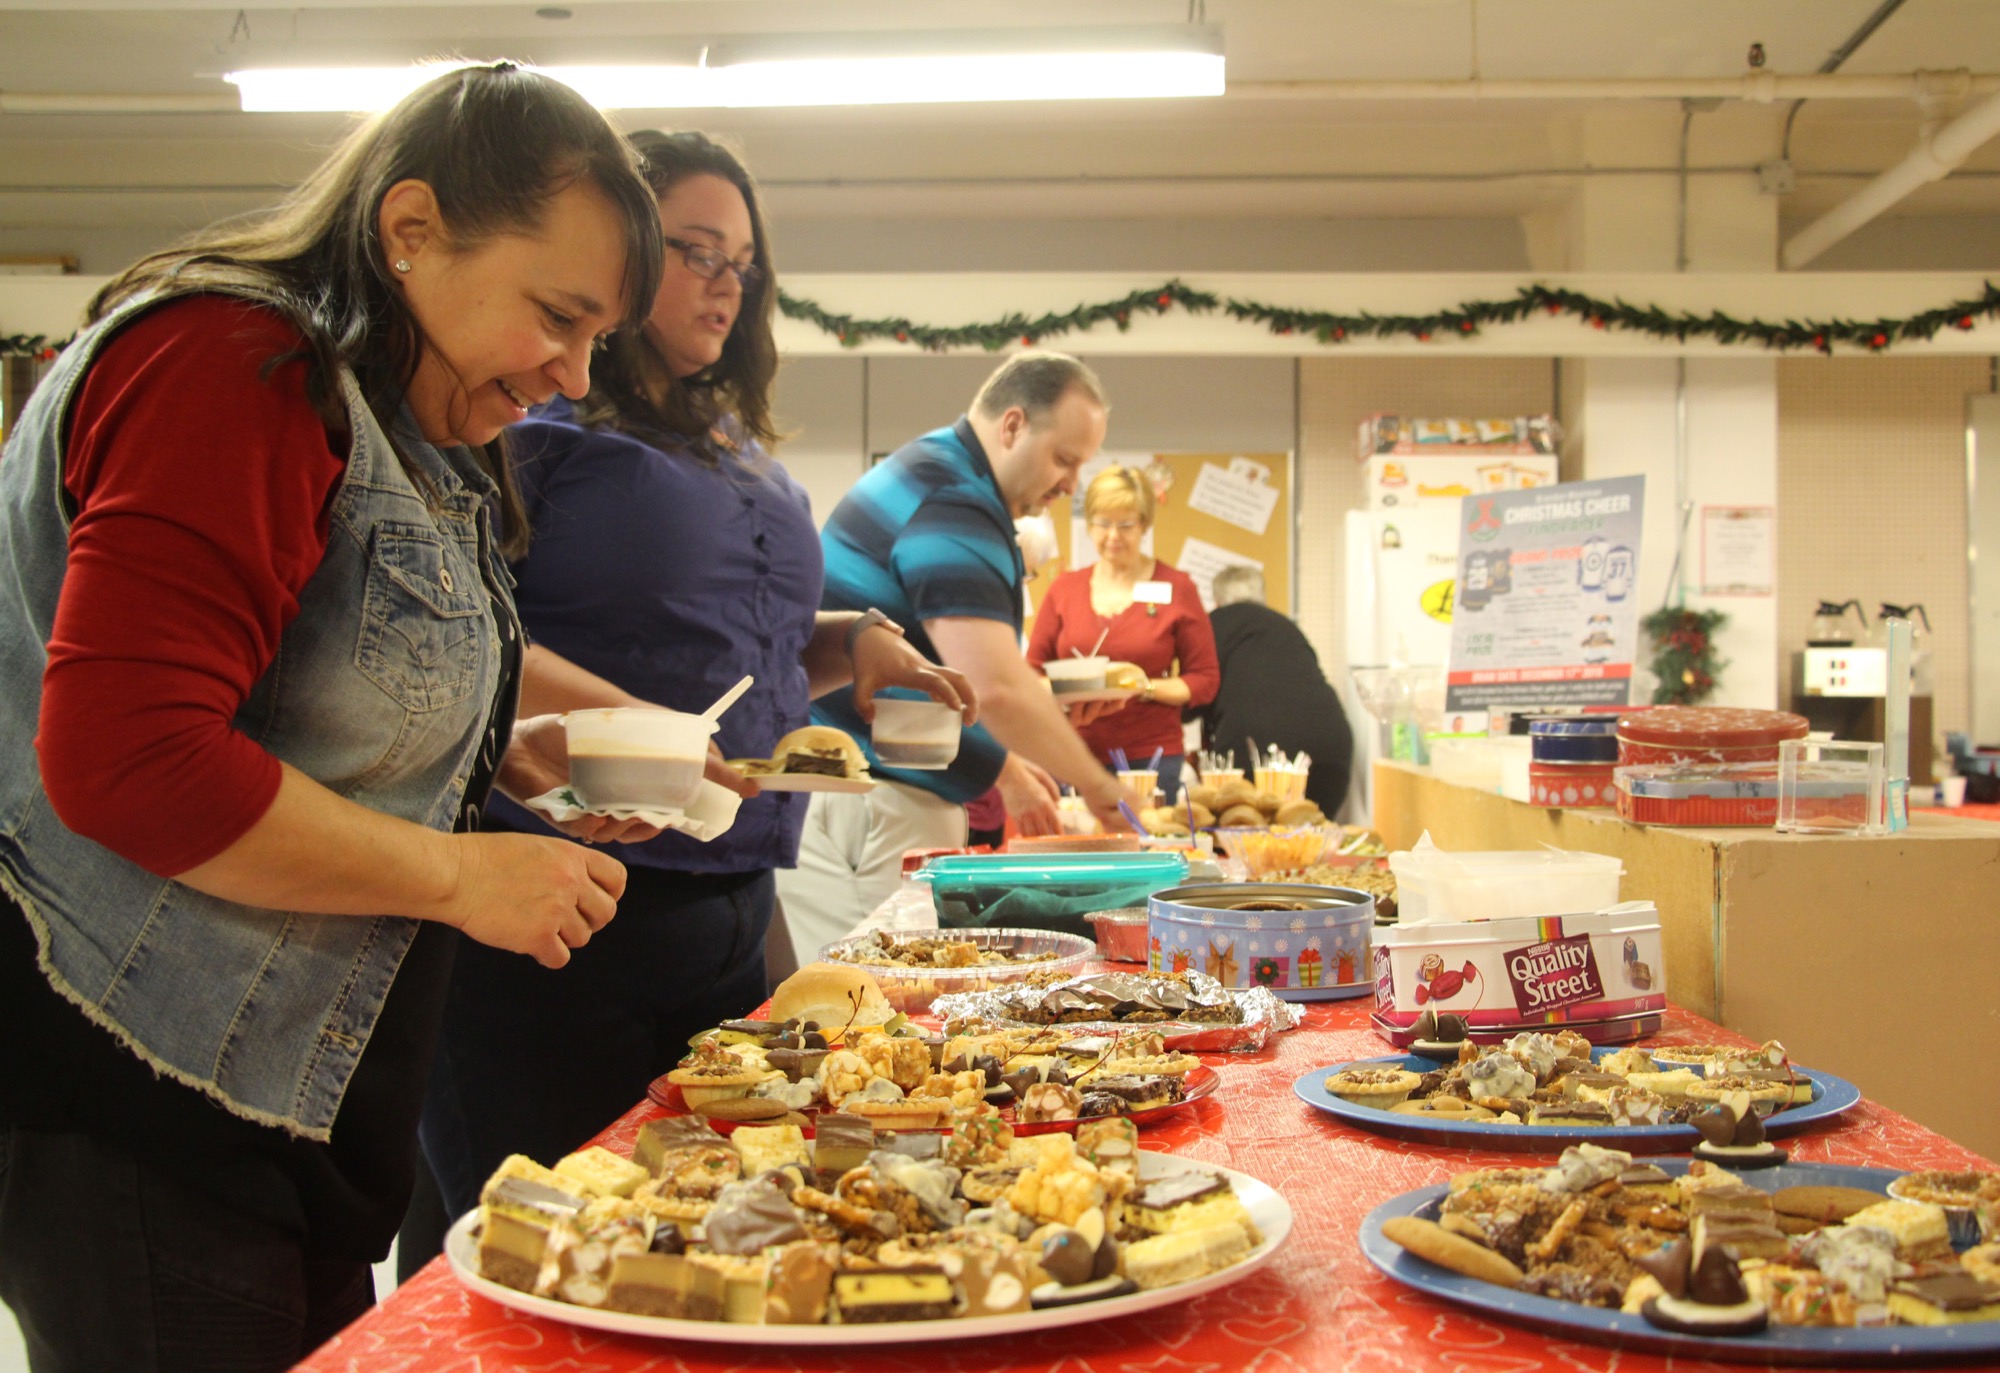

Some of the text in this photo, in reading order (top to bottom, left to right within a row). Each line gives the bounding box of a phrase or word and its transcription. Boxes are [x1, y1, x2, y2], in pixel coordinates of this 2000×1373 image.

[1504, 501, 1582, 525] CHRISTMAS
[1584, 494, 1630, 516] CHEER
[1510, 944, 1588, 981] Quality
[1523, 969, 1593, 1007] Street
